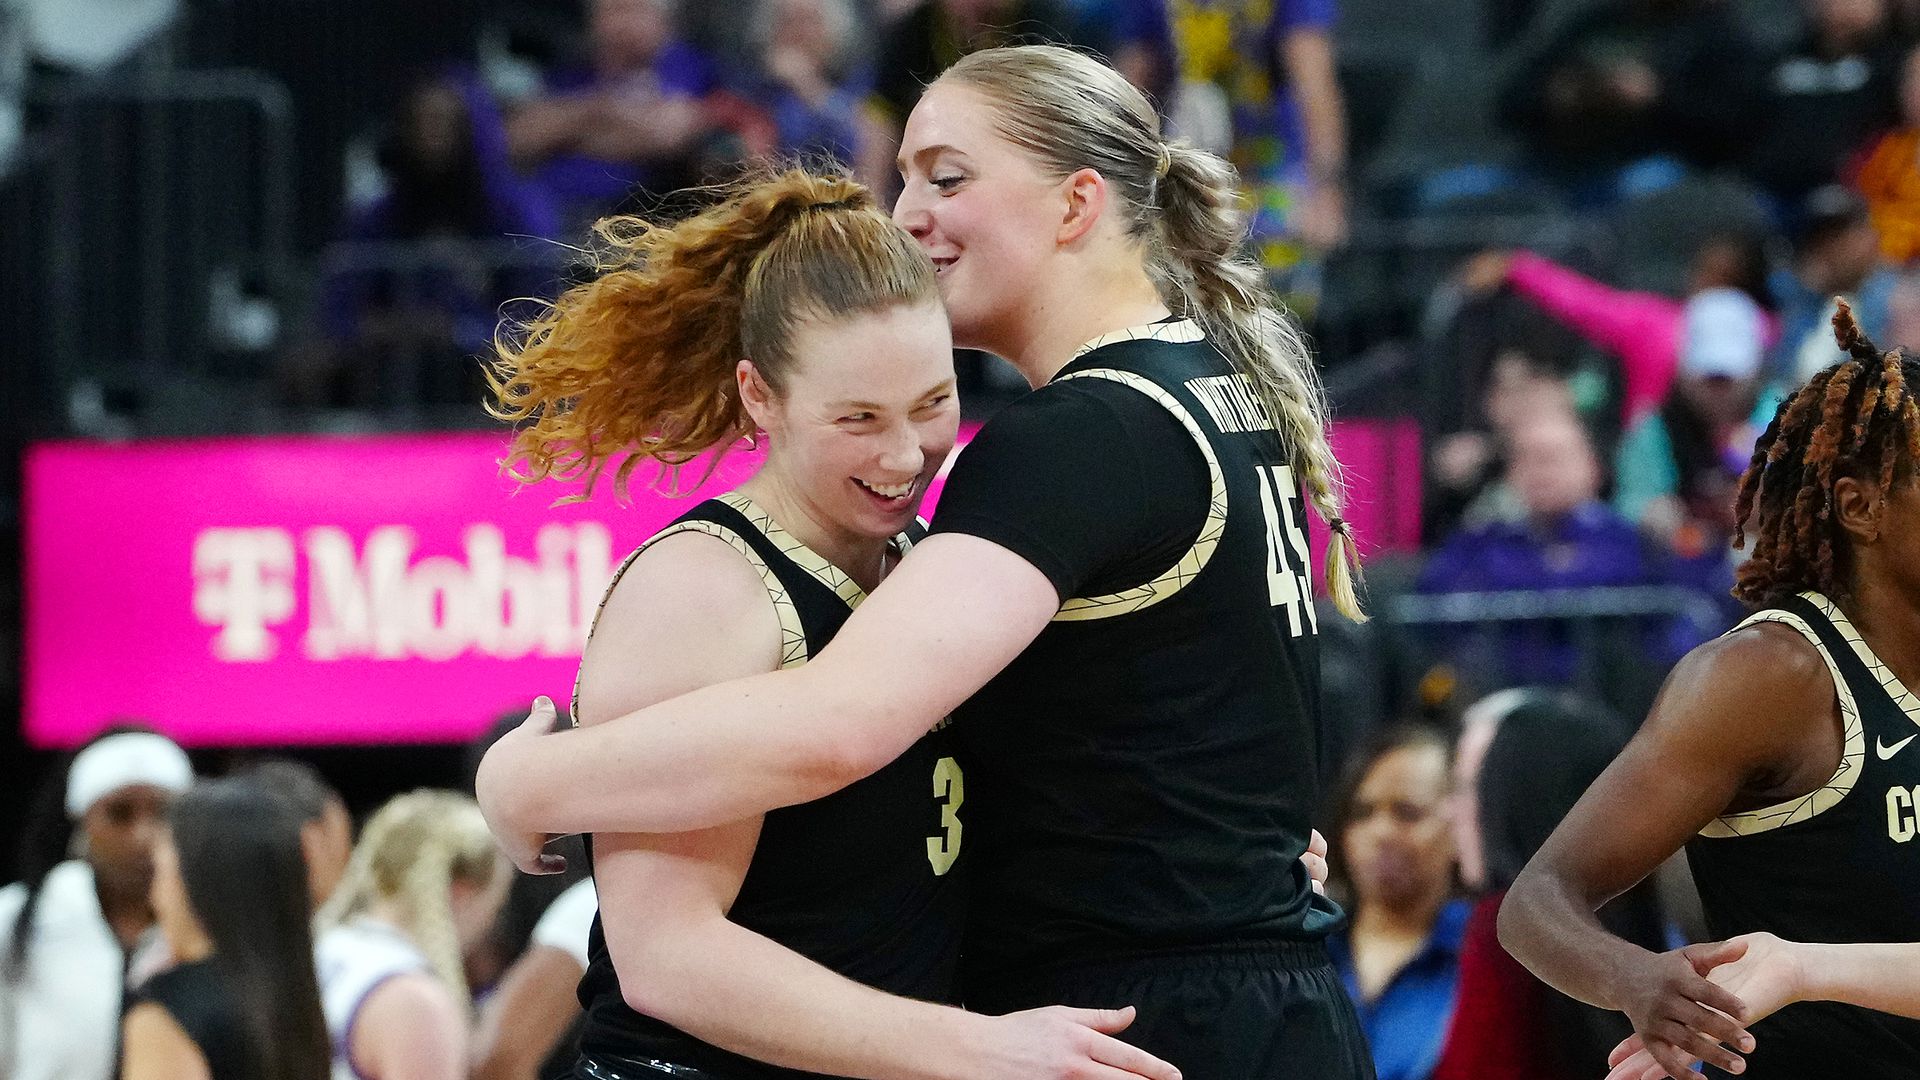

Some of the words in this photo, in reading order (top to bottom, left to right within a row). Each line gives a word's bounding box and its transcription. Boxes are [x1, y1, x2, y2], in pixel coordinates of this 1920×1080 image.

[1183, 373, 1277, 434] WHITTAKE
[304, 521, 620, 661] Mobil
[1254, 464, 1319, 638] 45
[926, 756, 964, 877] 3
